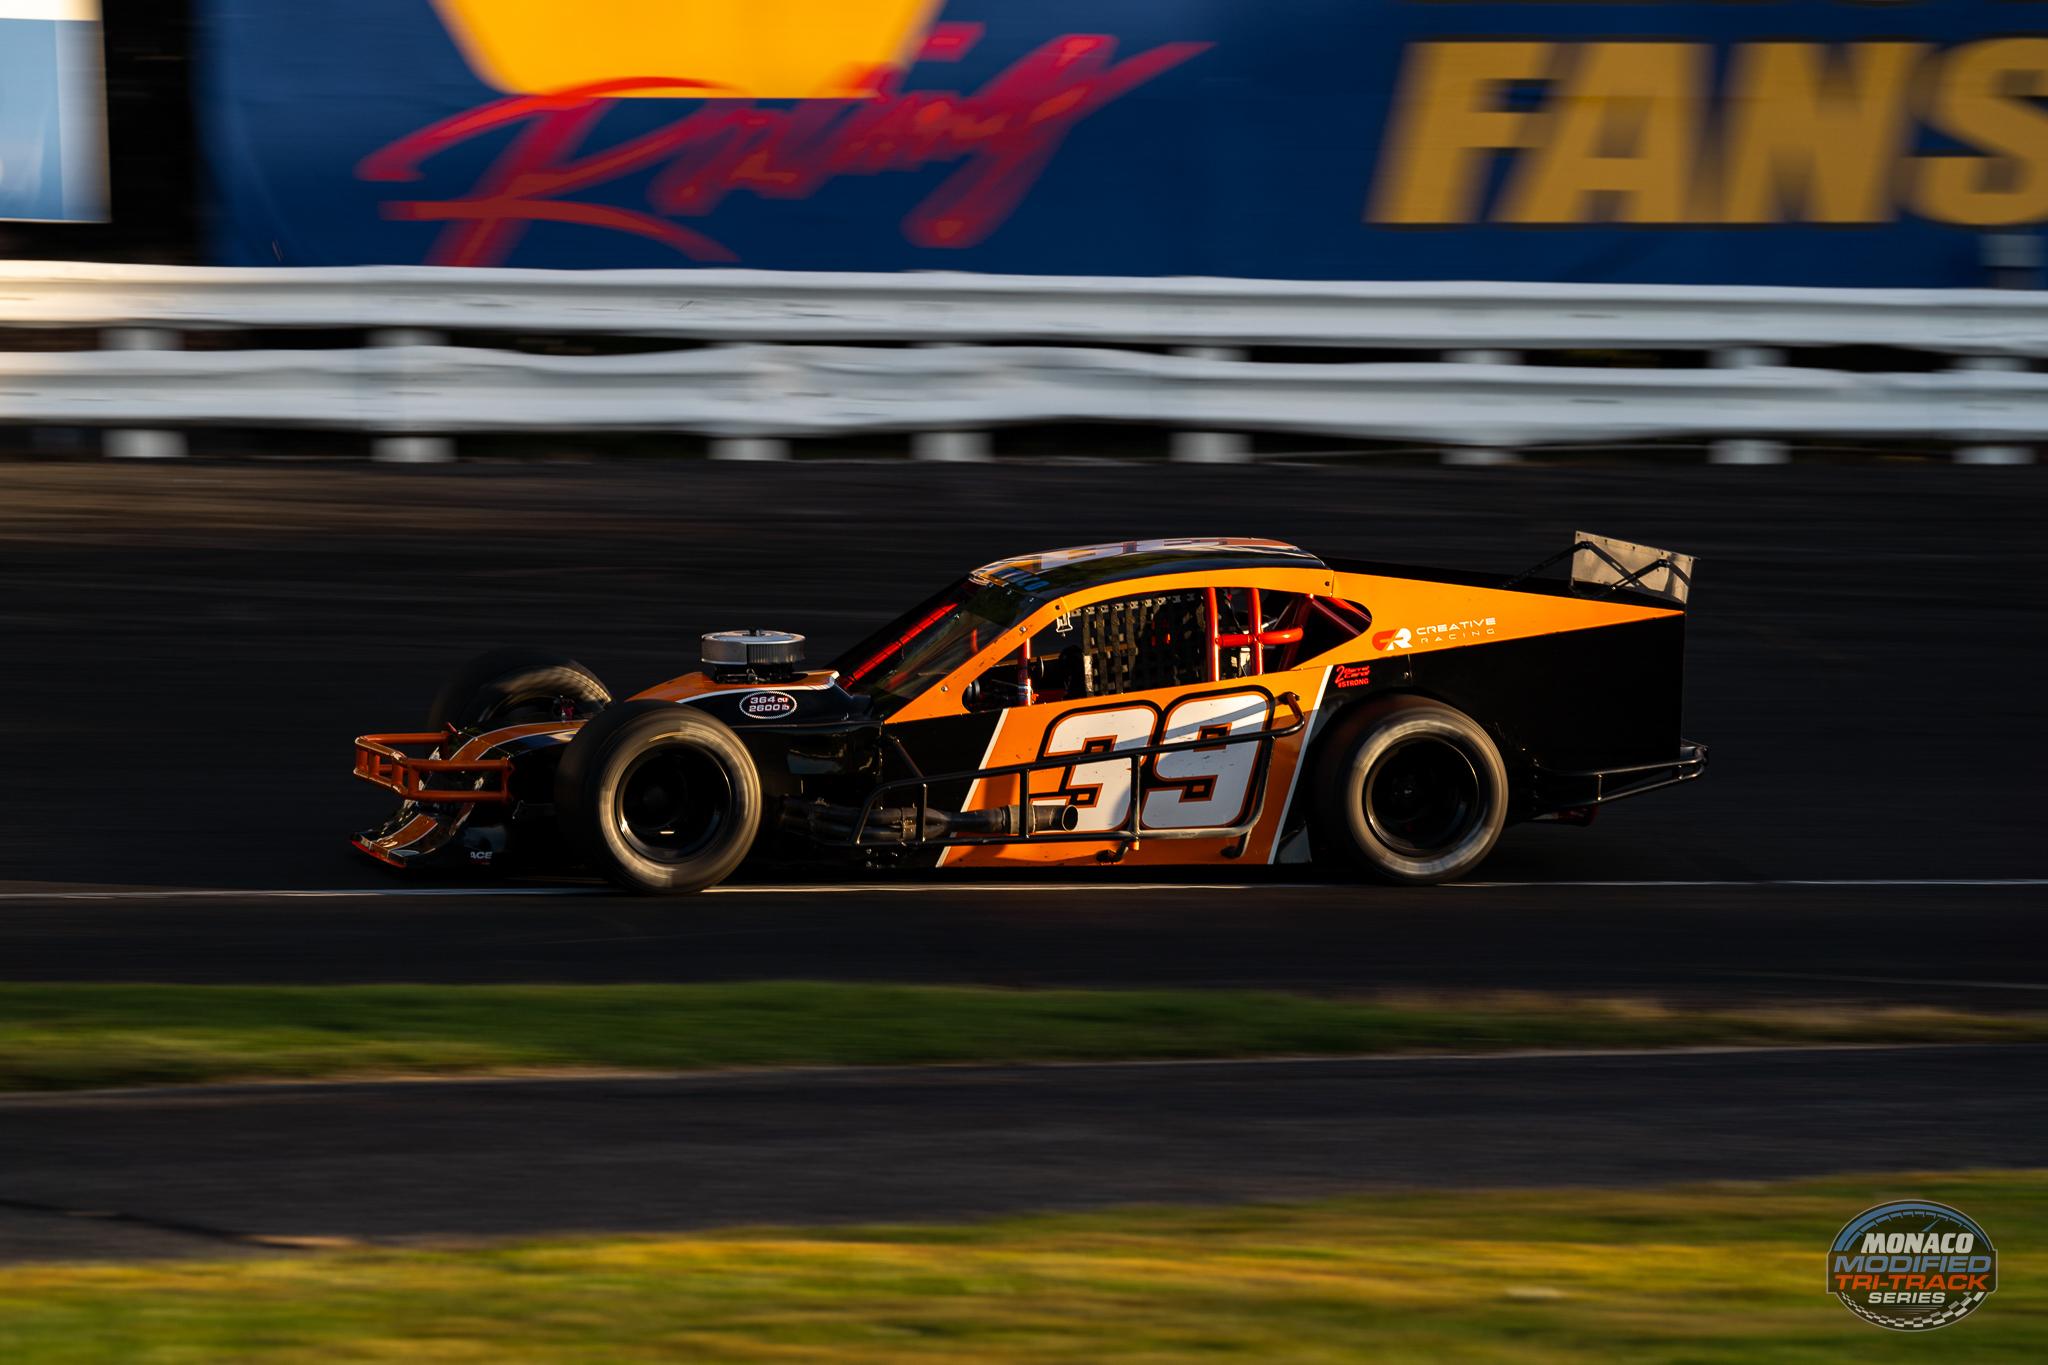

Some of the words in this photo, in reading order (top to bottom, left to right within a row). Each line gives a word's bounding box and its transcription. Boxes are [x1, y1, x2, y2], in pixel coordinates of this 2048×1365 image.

[1364, 38, 2048, 226] FANS
[1416, 617, 1496, 635] CREATIVE
[1421, 628, 1495, 643] RACING
[748, 704, 780, 712] 2600
[1028, 686, 1275, 833] 39
